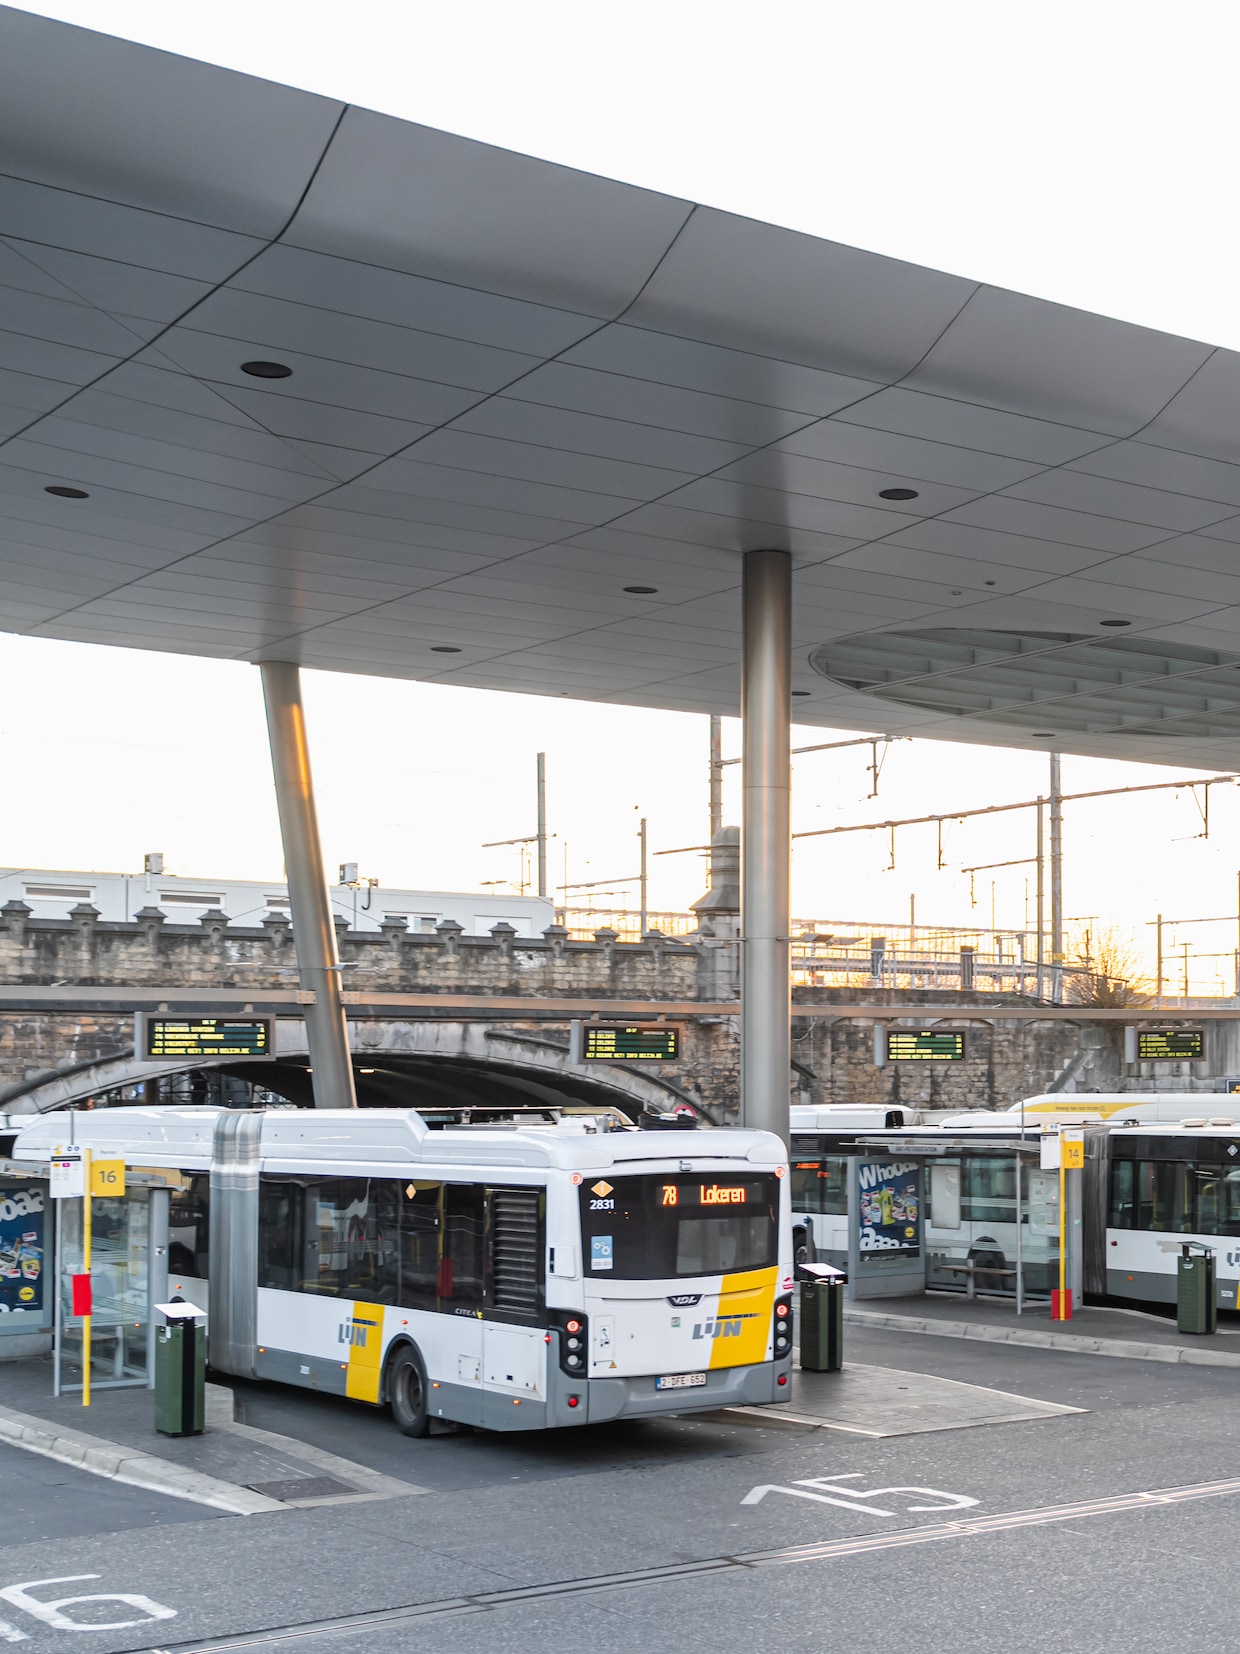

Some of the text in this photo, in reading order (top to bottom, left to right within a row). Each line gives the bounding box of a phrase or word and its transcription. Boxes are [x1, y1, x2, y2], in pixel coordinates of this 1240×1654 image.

[1068, 1149, 1079, 1159] 14
[99, 1171, 117, 1183] 16
[589, 1198, 615, 1210] 2831
[661, 1184, 747, 1205] 78 Lokeren
[671, 1296, 699, 1305] VDL
[338, 1323, 367, 1347] LIJN
[692, 1320, 742, 1340] LIJN
[739, 1472, 984, 1518] 15
[0, 1573, 179, 1643] 6
